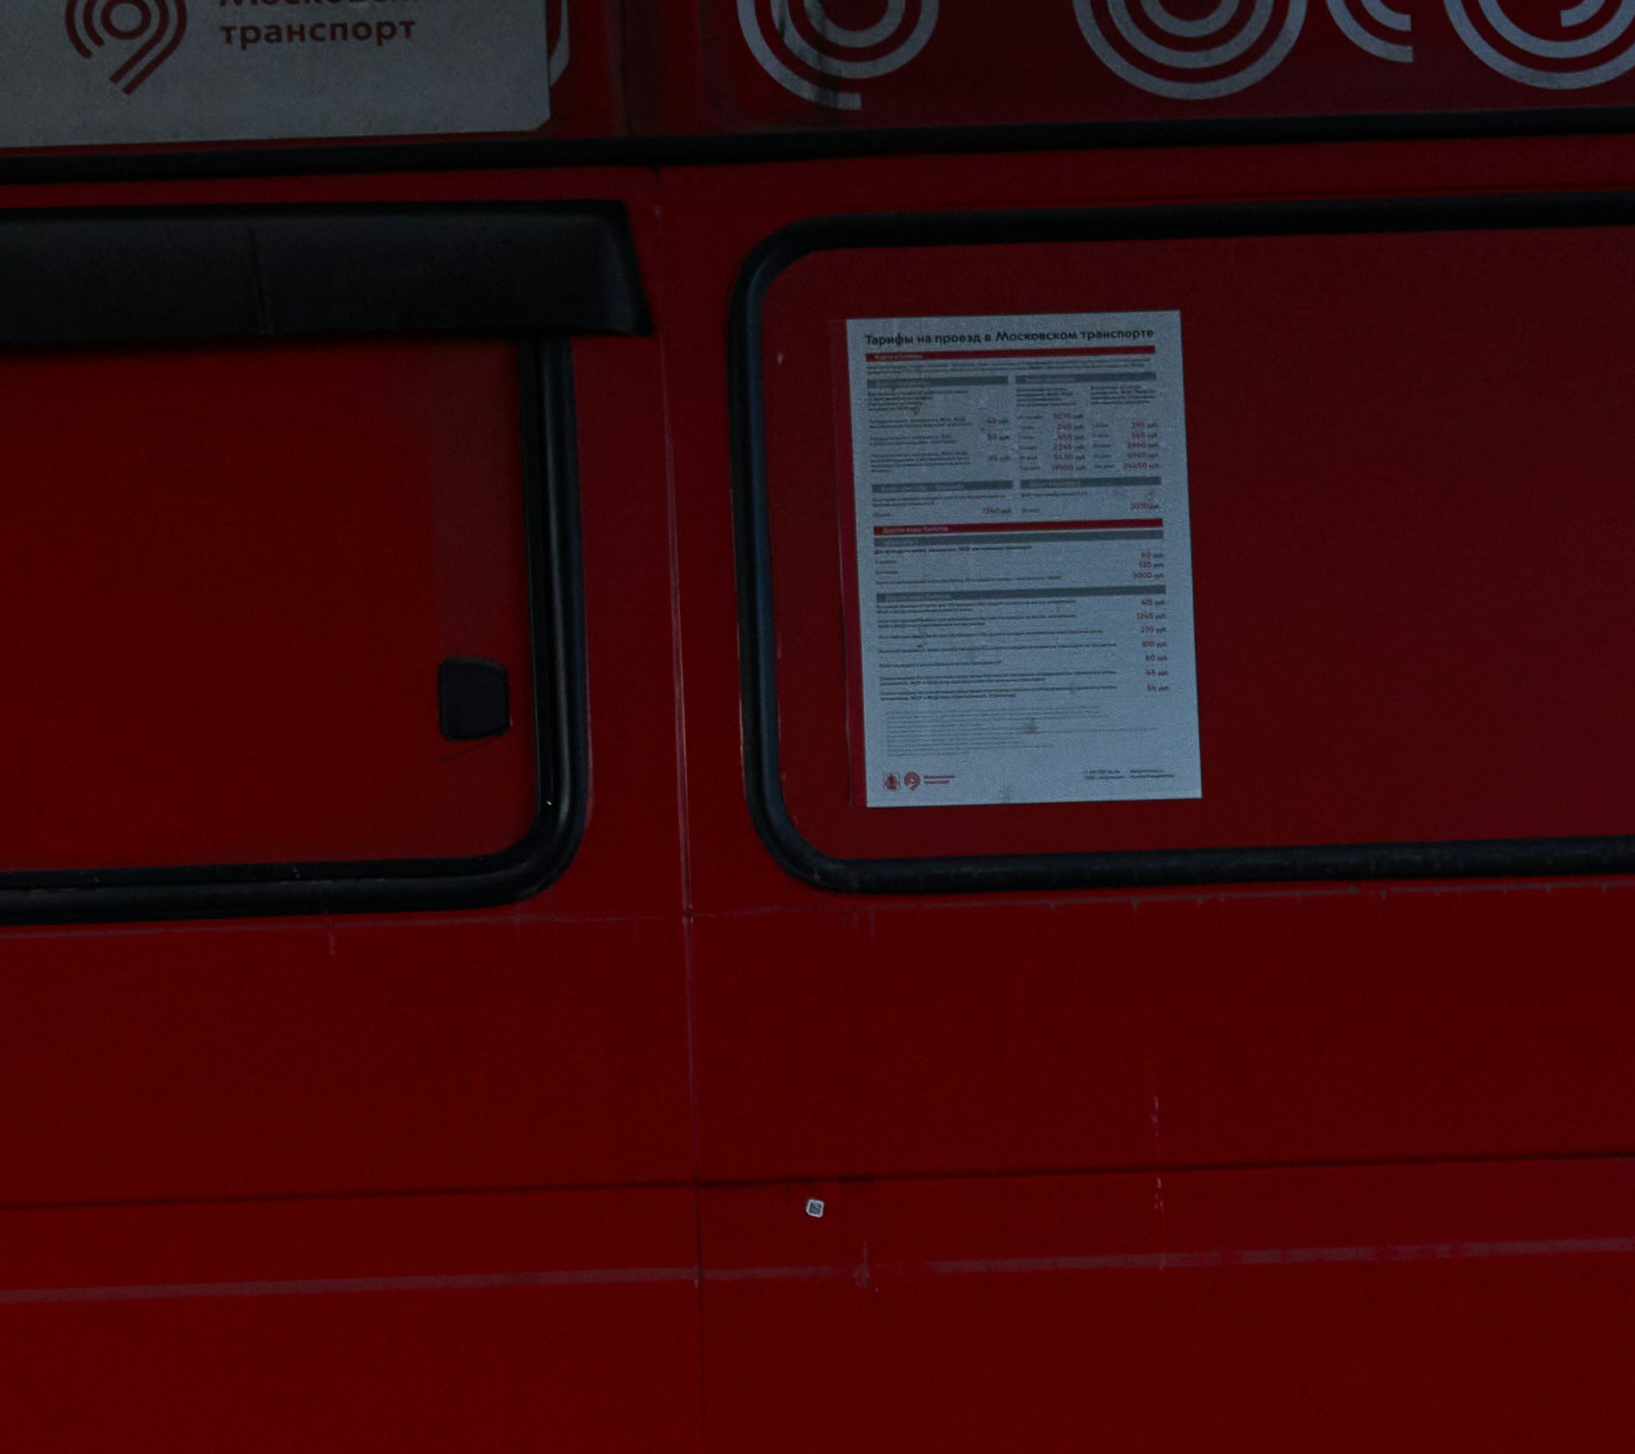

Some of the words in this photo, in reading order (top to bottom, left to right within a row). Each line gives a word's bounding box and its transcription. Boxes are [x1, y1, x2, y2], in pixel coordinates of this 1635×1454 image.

[220, 20, 417, 50] транспорт
[865, 332, 914, 346] Тарифы
[917, 335, 932, 344] на
[935, 333, 982, 345] проезд
[995, 330, 1078, 343] Московском
[1081, 328, 1154, 341] транспорте
